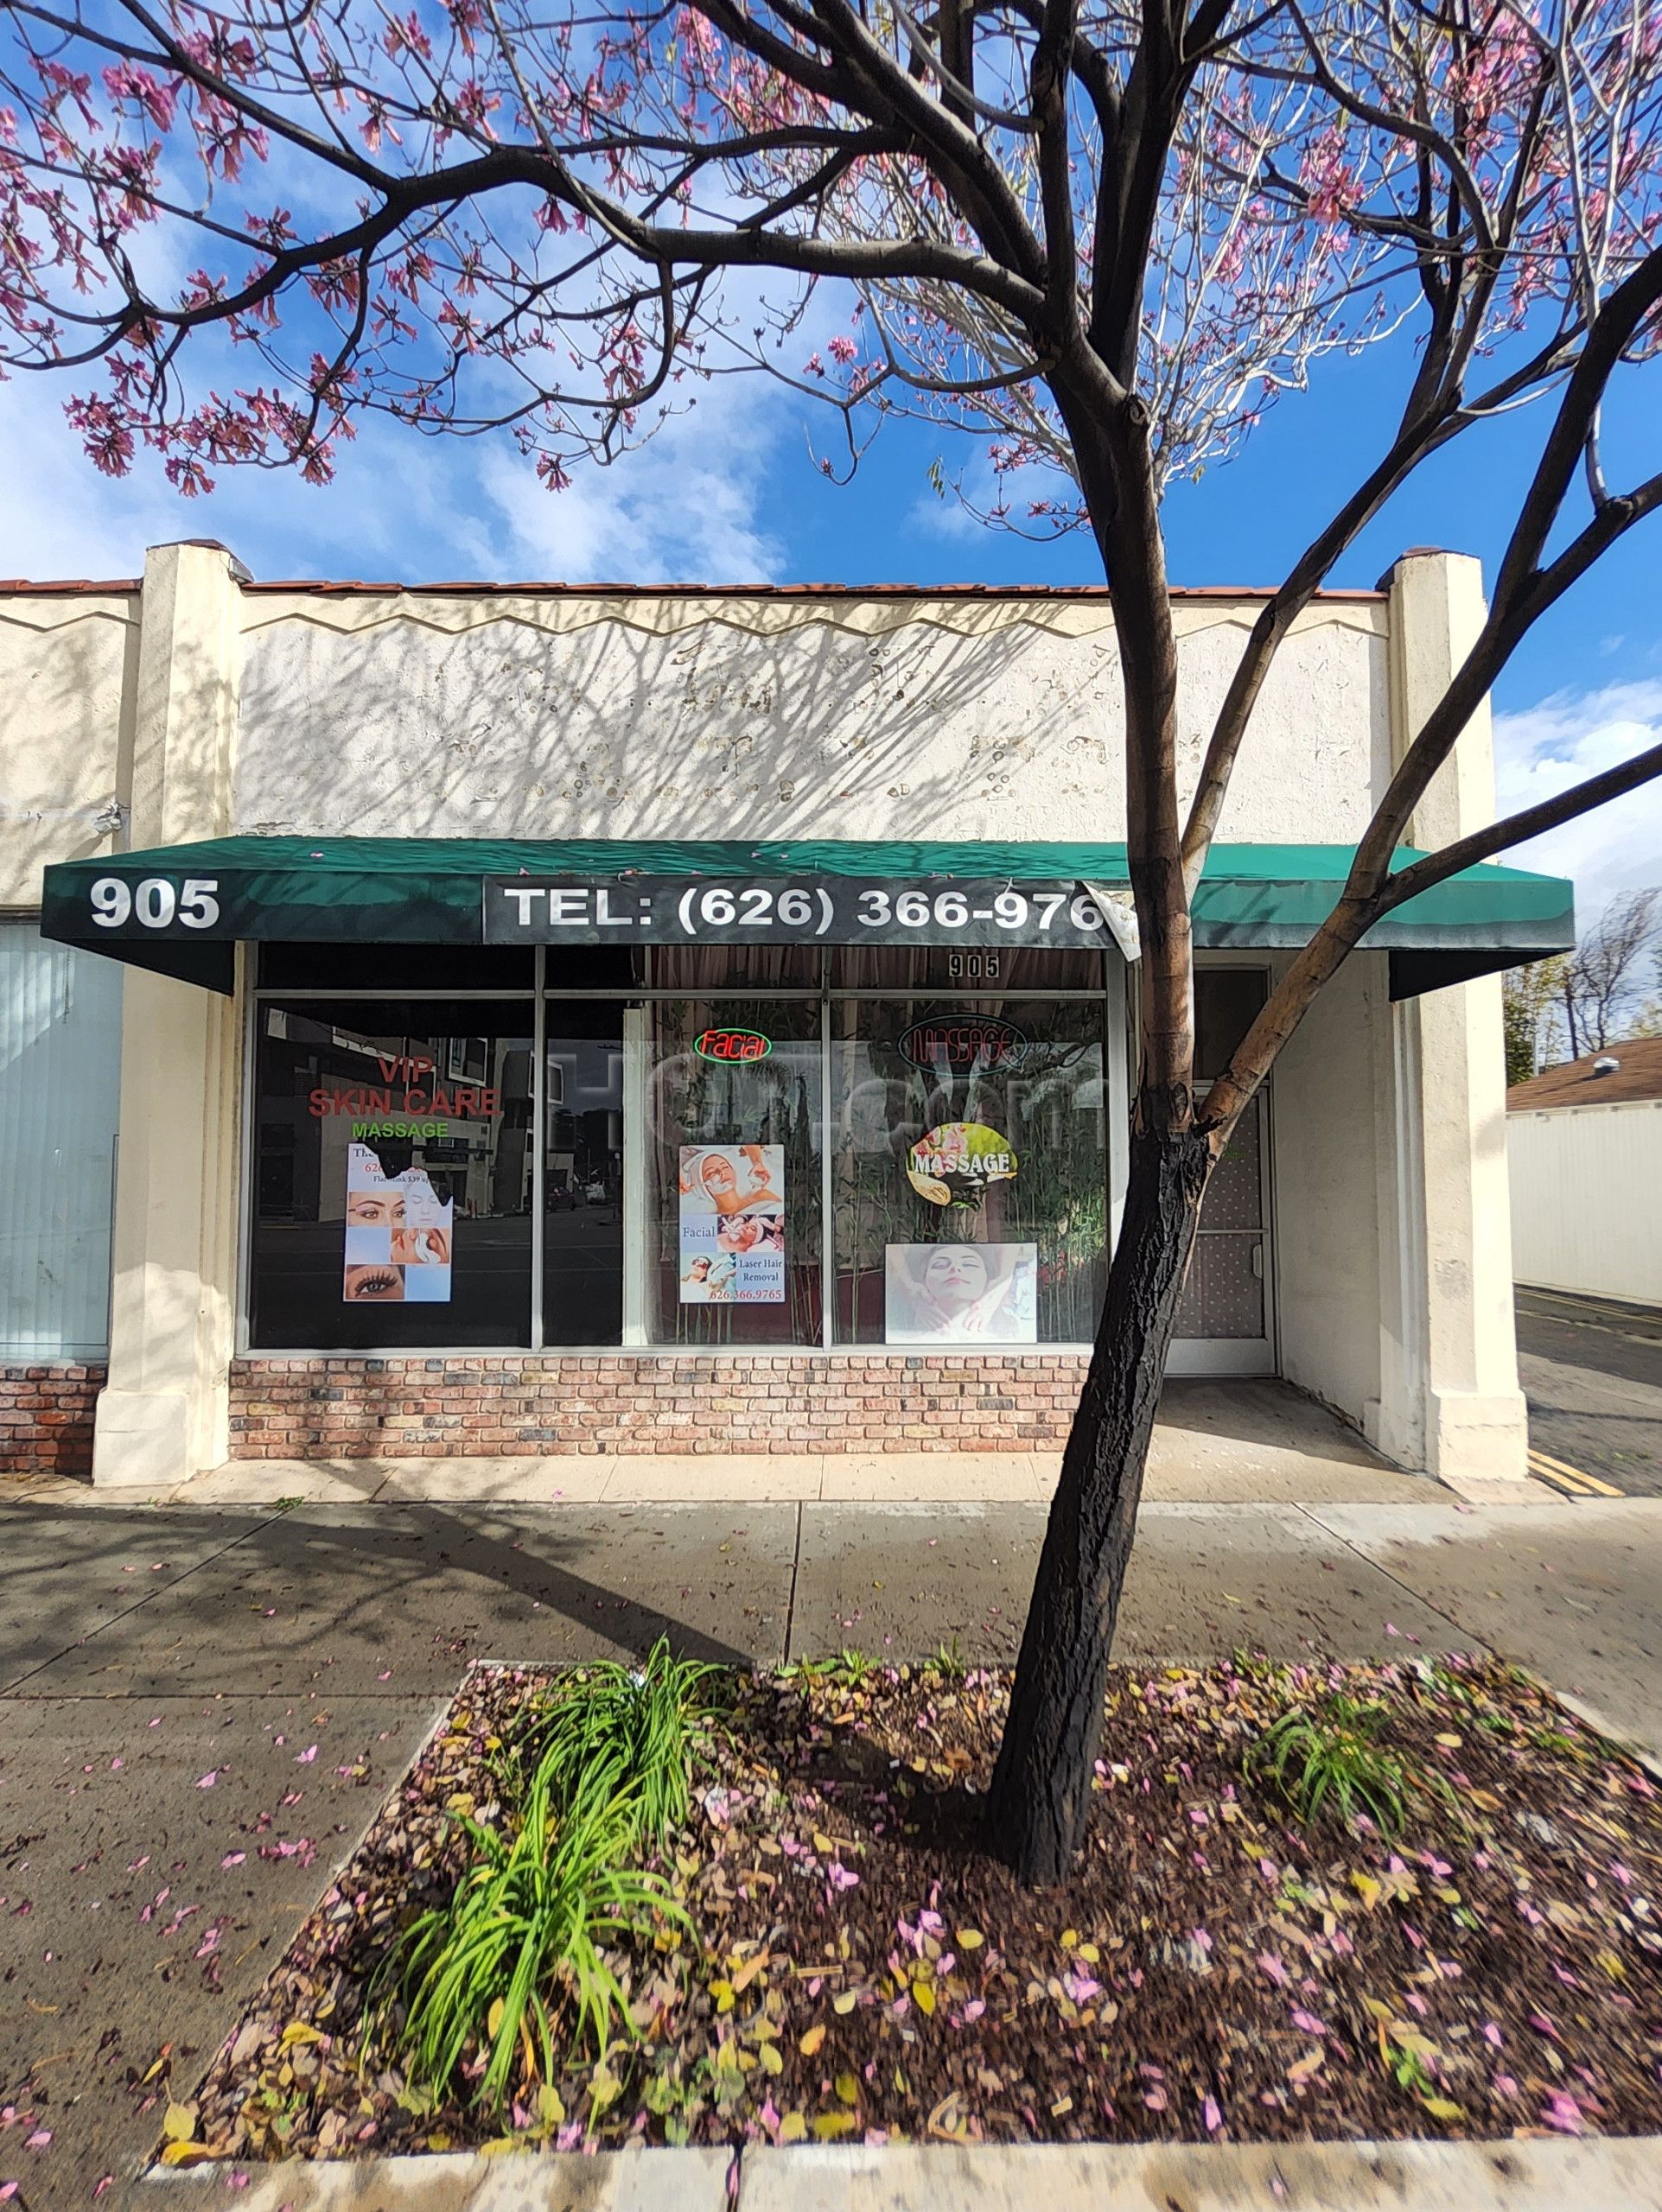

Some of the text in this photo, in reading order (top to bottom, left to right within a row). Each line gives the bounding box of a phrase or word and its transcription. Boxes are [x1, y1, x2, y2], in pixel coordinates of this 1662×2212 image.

[90, 877, 220, 929] 905
[504, 887, 1105, 935] TEL: (626) 366-976
[951, 955, 999, 978] 905
[700, 1030, 765, 1058] Facial
[913, 1027, 1011, 1063] MASSAGE
[378, 1056, 435, 1083] VIP
[308, 1088, 502, 1116] SKIN CARE
[351, 1123, 449, 1138] MASSAGE
[914, 1154, 1009, 1173] MASSAGE
[682, 1226, 716, 1238] Facial
[739, 1259, 782, 1268] Laser Hair
[743, 1272, 780, 1282] Removal
[709, 1289, 782, 1300] 626.366.9765
